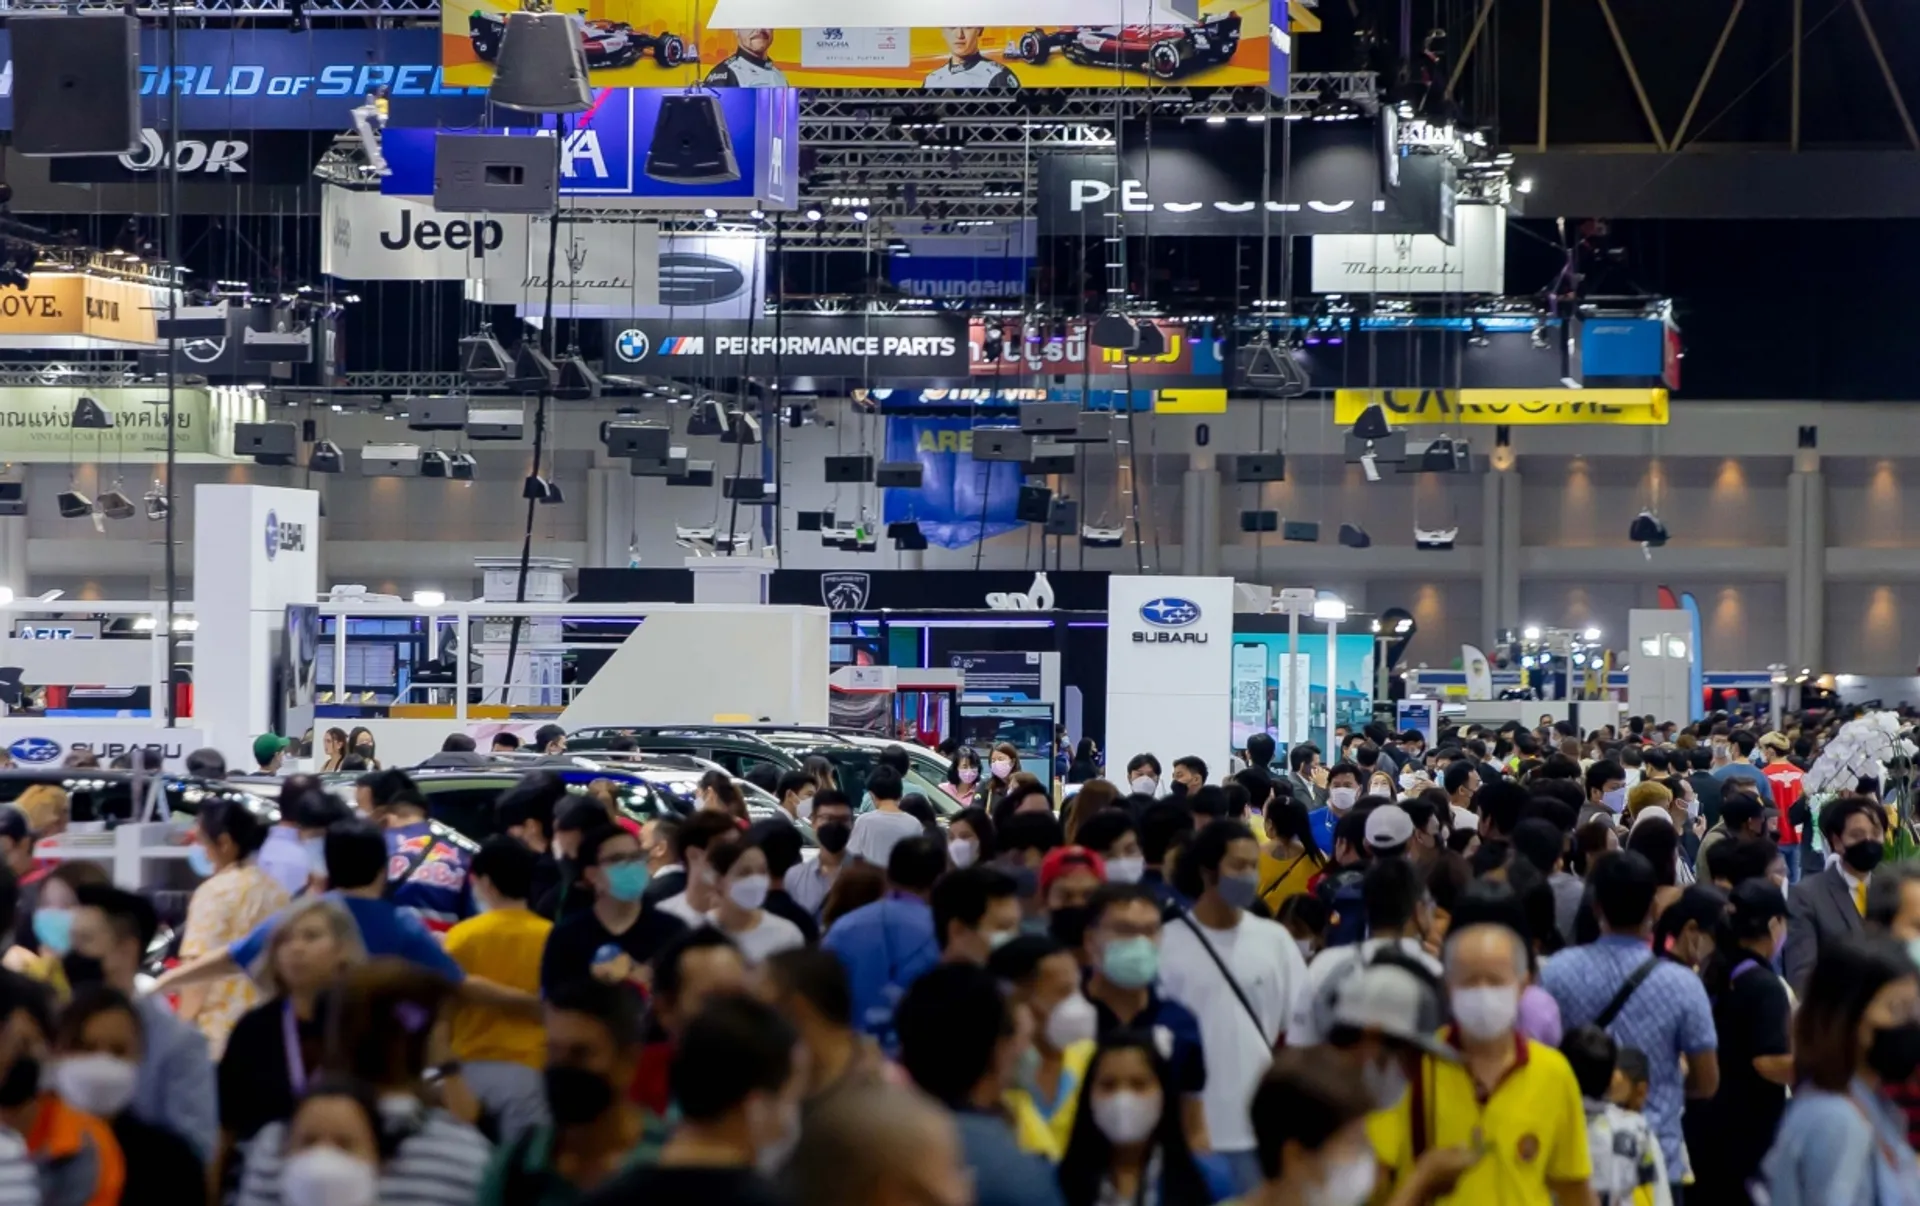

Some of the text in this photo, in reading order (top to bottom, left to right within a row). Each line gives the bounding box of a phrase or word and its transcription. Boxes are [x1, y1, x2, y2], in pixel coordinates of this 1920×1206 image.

[816, 41, 849, 49] SINGHA
[380, 209, 503, 258] Jeep
[1342, 261, 1463, 275] Maserati
[521, 276, 635, 289] Maserati
[0, 295, 63, 317] OVE.
[715, 336, 879, 356] PERFORMANCE
[883, 336, 956, 357] PARTS
[30, 432, 69, 442] VINTAGE
[75, 432, 94, 442] CAR
[125, 432, 138, 442] OF
[1131, 631, 1209, 644] SUBARU
